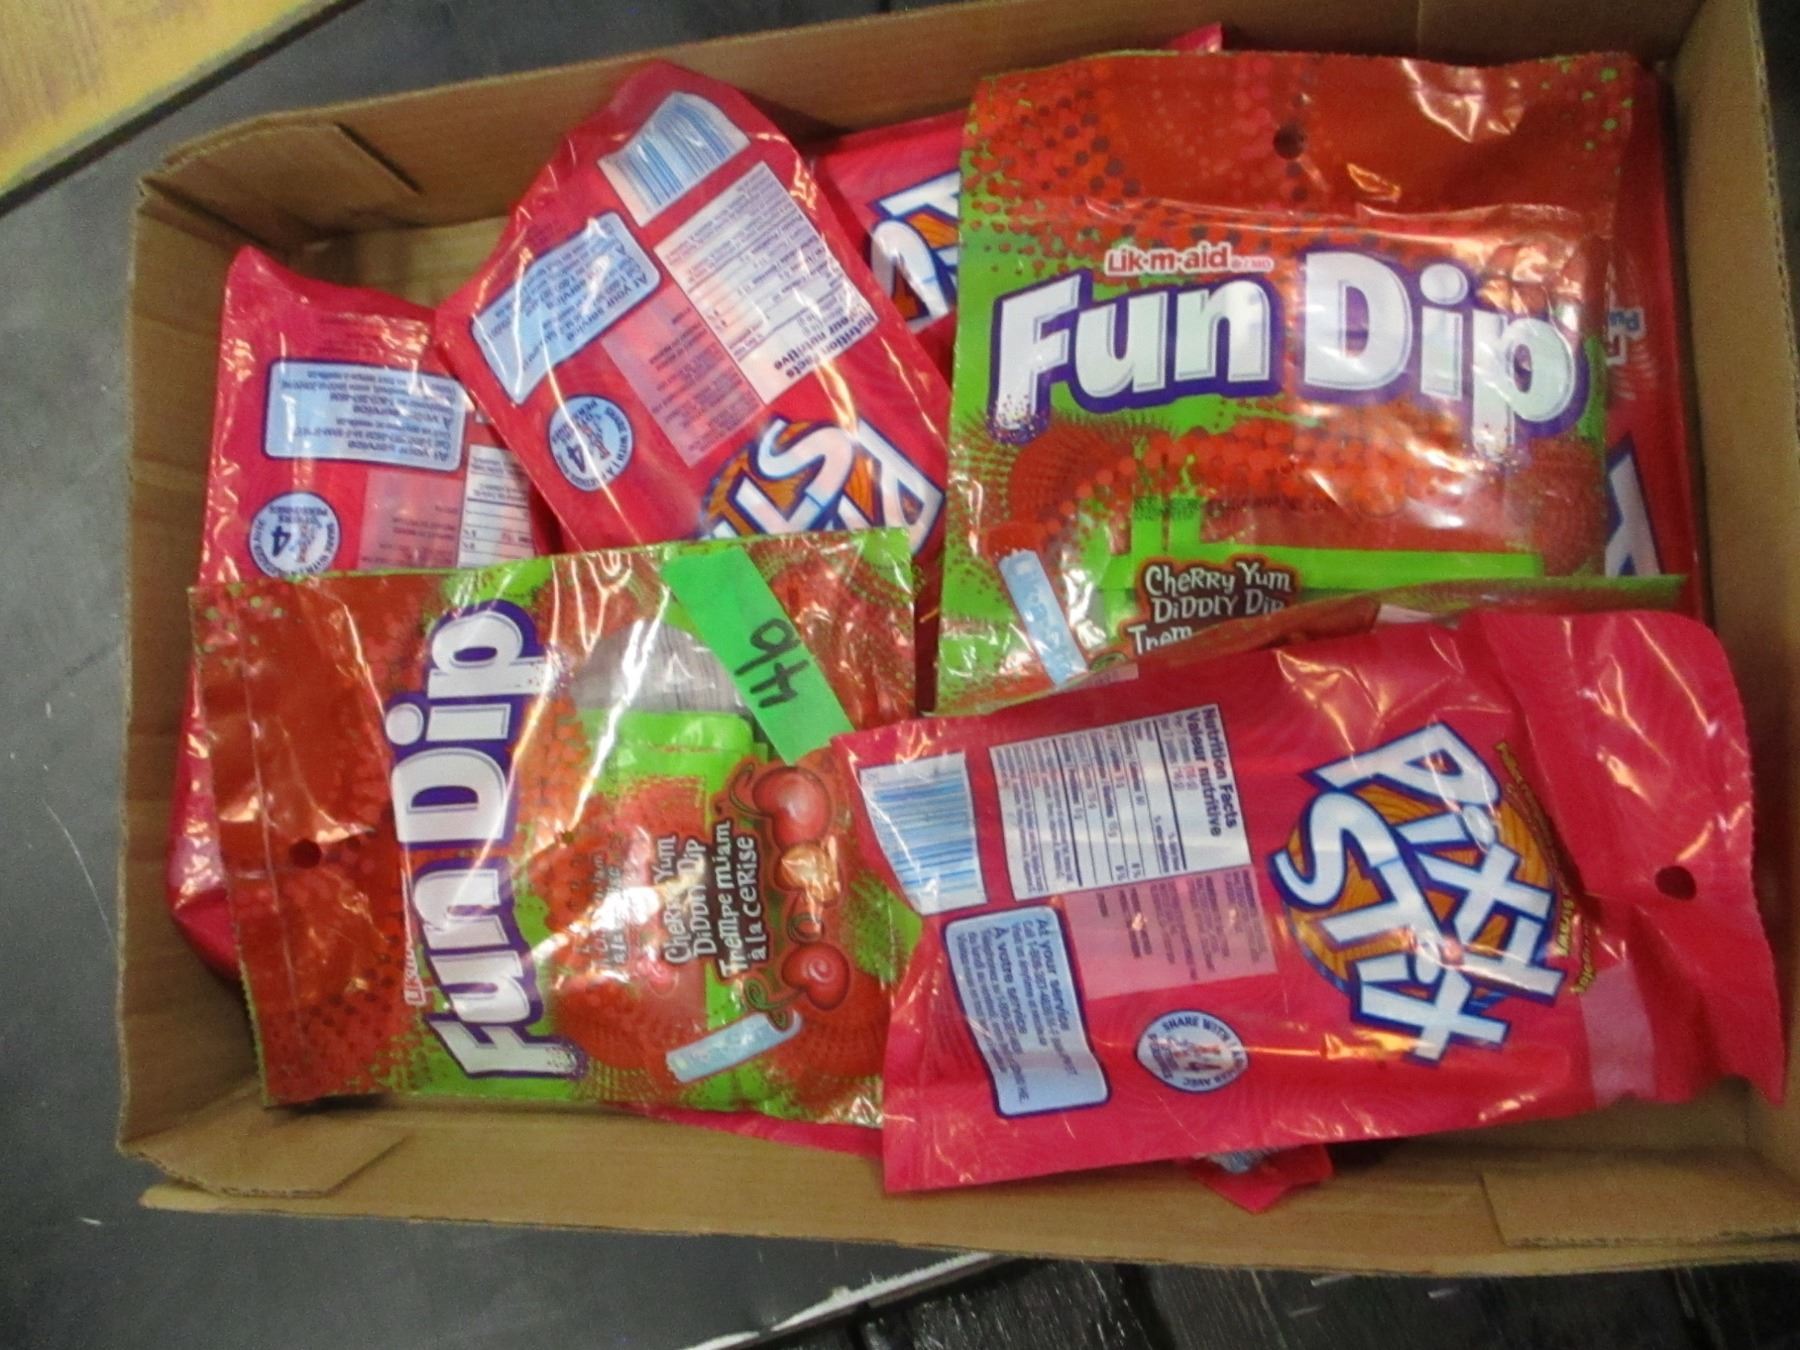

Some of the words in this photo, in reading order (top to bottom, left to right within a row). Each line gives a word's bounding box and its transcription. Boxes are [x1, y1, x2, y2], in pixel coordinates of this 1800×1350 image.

[605, 283, 632, 307] your
[989, 275, 1274, 438] Fun
[1302, 251, 1580, 464] Dip
[566, 444, 583, 473] 4
[271, 526, 290, 557] 4
[1236, 561, 1289, 590] Yum
[387, 608, 547, 845] Dip
[1186, 711, 1207, 762] Valeur
[1197, 766, 1223, 837] nutritive
[1203, 708, 1229, 778] Nutrition
[1219, 783, 1239, 828] Facts
[651, 836, 675, 878] Yum
[1035, 916, 1051, 936] At
[408, 865, 581, 1080] Fun
[1038, 939, 1058, 974] your
[996, 942, 1015, 983] votre
[1008, 985, 1028, 1034] service
[1050, 978, 1072, 1031] service
